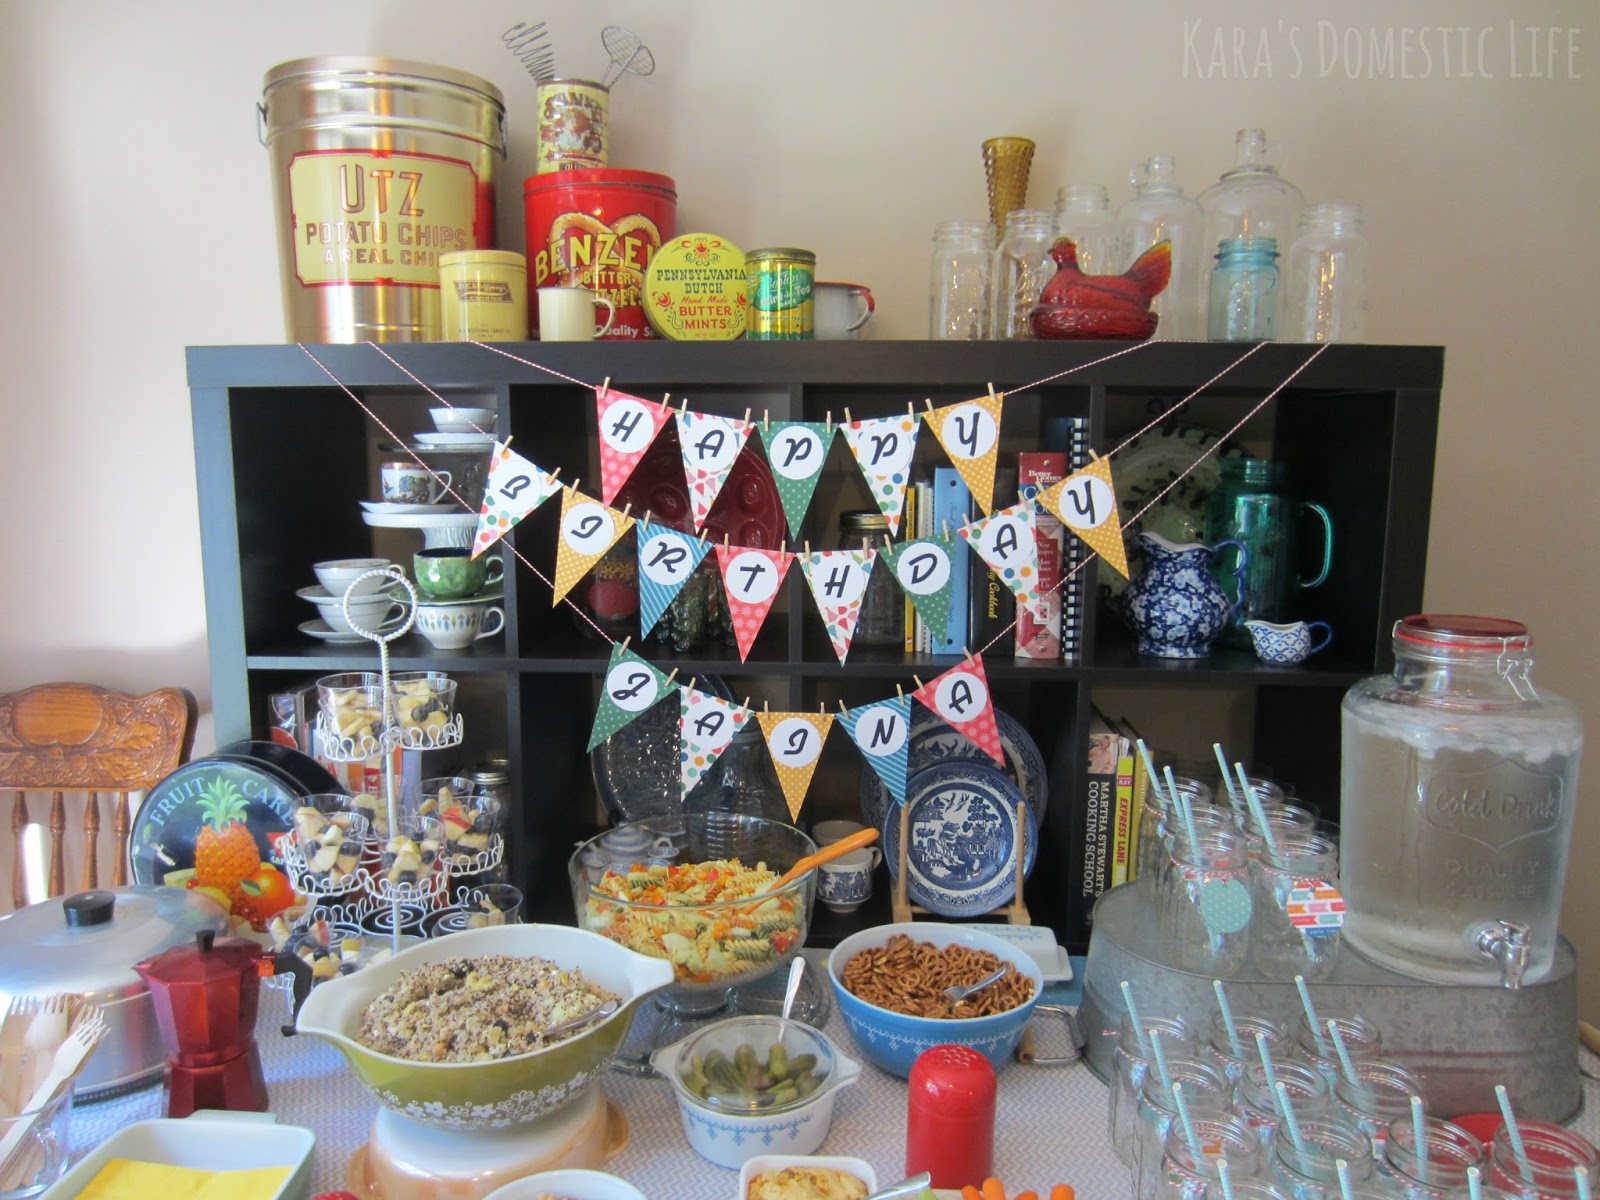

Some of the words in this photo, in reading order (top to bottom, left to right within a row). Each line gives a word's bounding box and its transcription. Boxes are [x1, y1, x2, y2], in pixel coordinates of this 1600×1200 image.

[339, 164, 424, 217] UTZ
[305, 221, 388, 246] POTATO
[397, 222, 466, 250] CHIPS
[323, 249, 334, 264] A
[340, 248, 394, 265] REAL
[583, 271, 632, 285] BETTER
[656, 269, 747, 281] PENNSYLVANIA
[685, 282, 723, 294] DUTCH
[679, 305, 732, 317] BUTTER
[681, 295, 703, 304] Hand
[707, 295, 729, 304] Made
[596, 325, 639, 339] Quality
[684, 318, 727, 330] MINTS
[611, 410, 981, 467] HAPPY
[1027, 469, 1052, 478] Better
[988, 582, 1001, 619] Cookbook
[1118, 779, 1131, 787] RAY
[150, 777, 205, 827] FRUIT
[242, 779, 295, 826] CAKE
[1086, 780, 1099, 842] COOKING
[1098, 781, 1110, 832] MARTHA
[1436, 787, 1492, 819] Cold
[1118, 797, 1128, 839] EXPRESS
[1116, 840, 1126, 864] LANE
[1082, 844, 1095, 897] SCHOOL
[1094, 834, 1108, 898] STEWART'S
